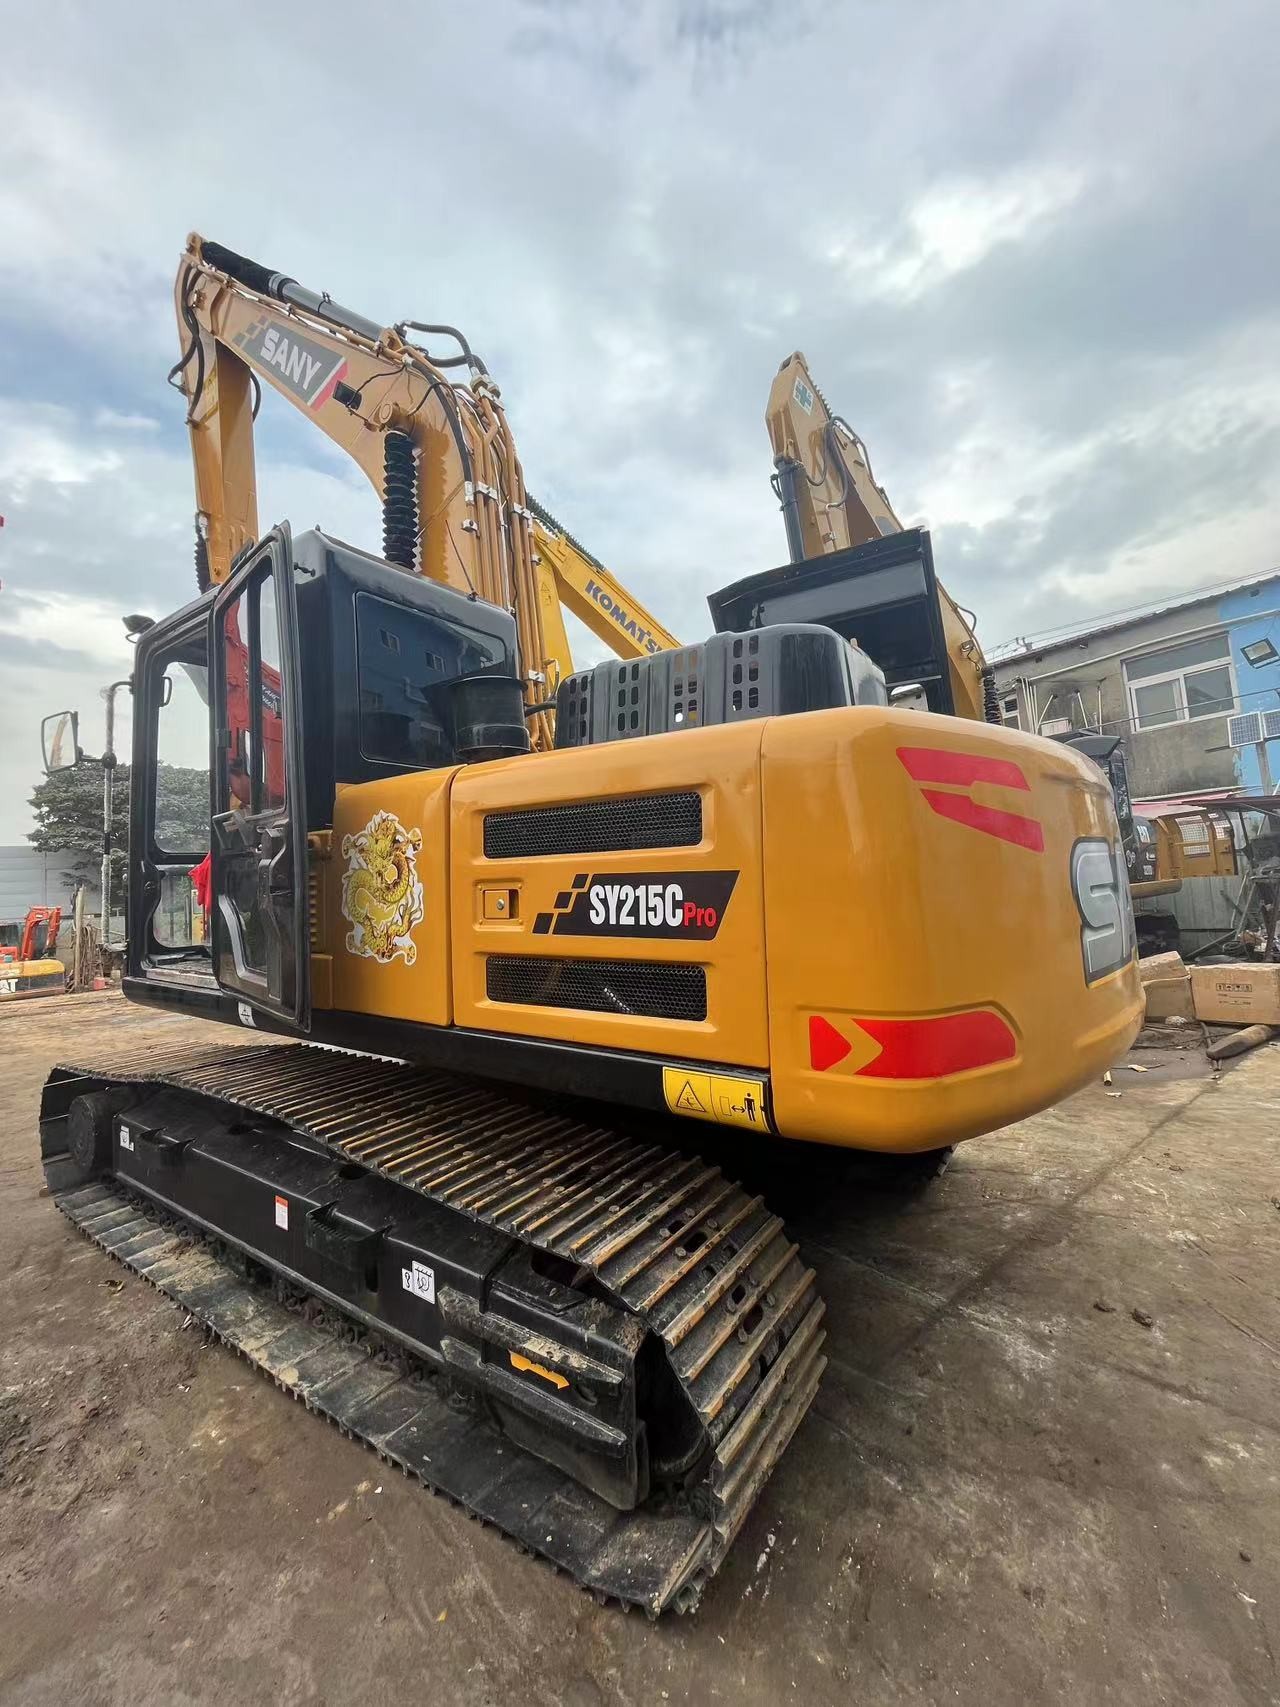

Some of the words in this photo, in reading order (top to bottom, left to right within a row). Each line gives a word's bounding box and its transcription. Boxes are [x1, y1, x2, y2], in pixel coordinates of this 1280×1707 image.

[260, 328, 322, 391] SANY
[584, 579, 663, 654] KOMATS
[589, 883, 684, 928] SY215C
[683, 902, 718, 928] Pro
